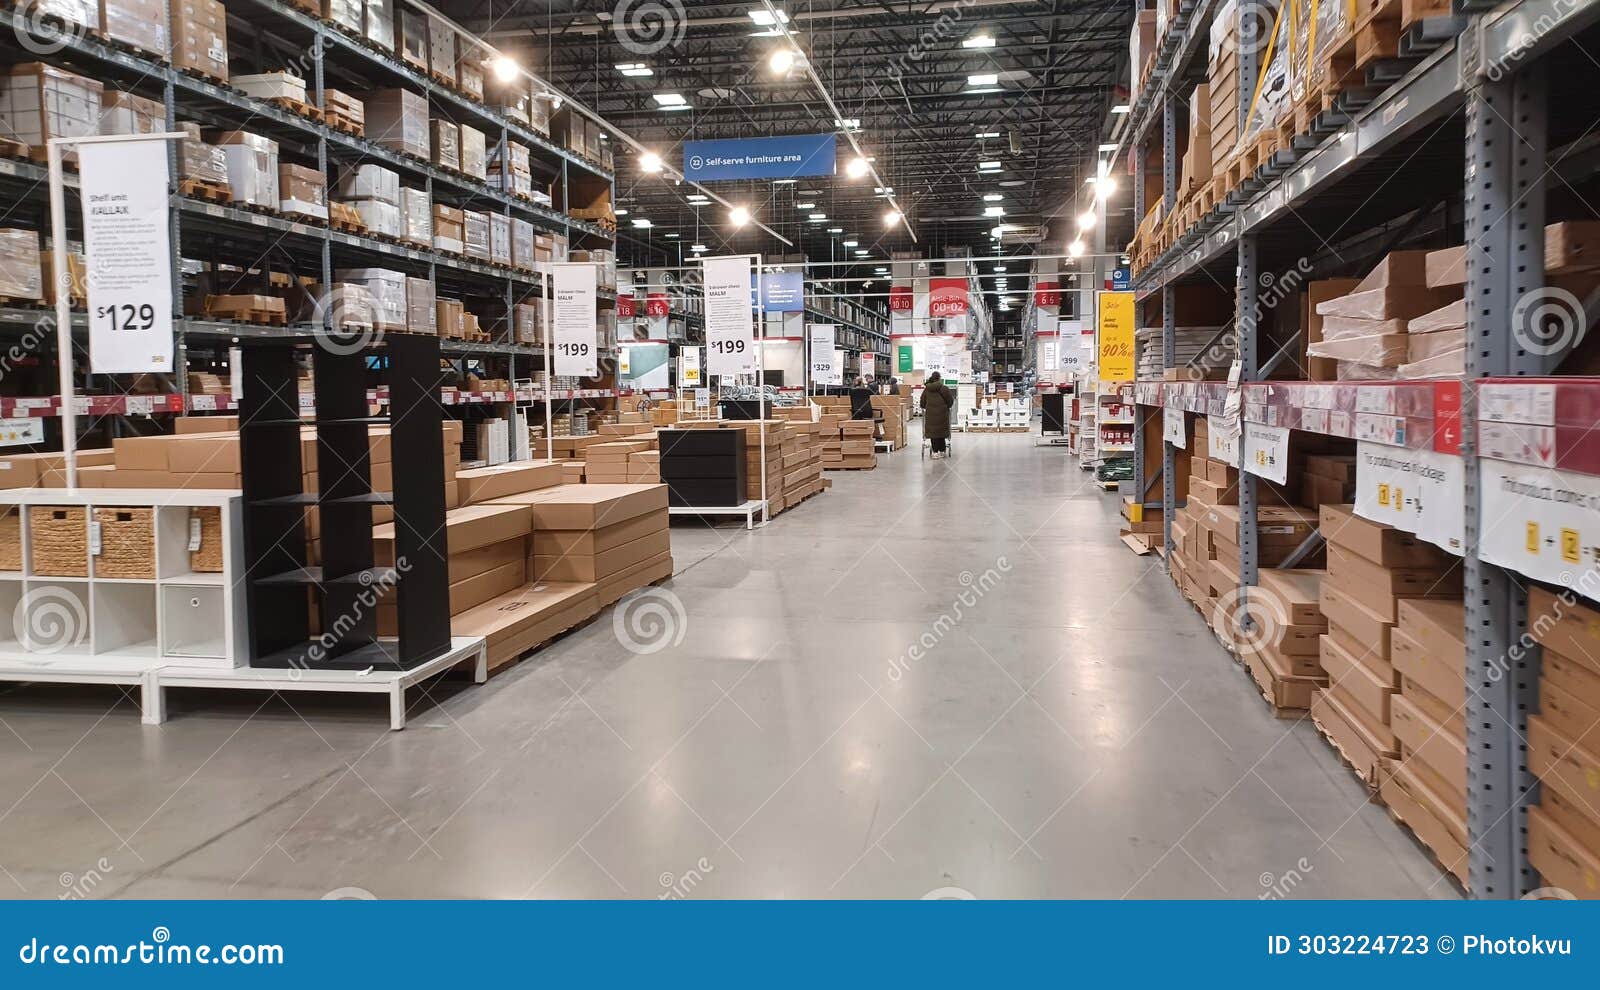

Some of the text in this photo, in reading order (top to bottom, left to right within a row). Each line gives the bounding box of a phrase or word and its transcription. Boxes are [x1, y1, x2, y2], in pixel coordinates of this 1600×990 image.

[706, 157, 744, 166] Self-serve
[745, 155, 783, 165] furniture
[97, 304, 154, 331] $129
[621, 307, 630, 315] 18
[558, 343, 589, 356] $199
[711, 340, 745, 354] $199
[1102, 342, 1129, 358] 90%
[813, 363, 830, 371] $329
